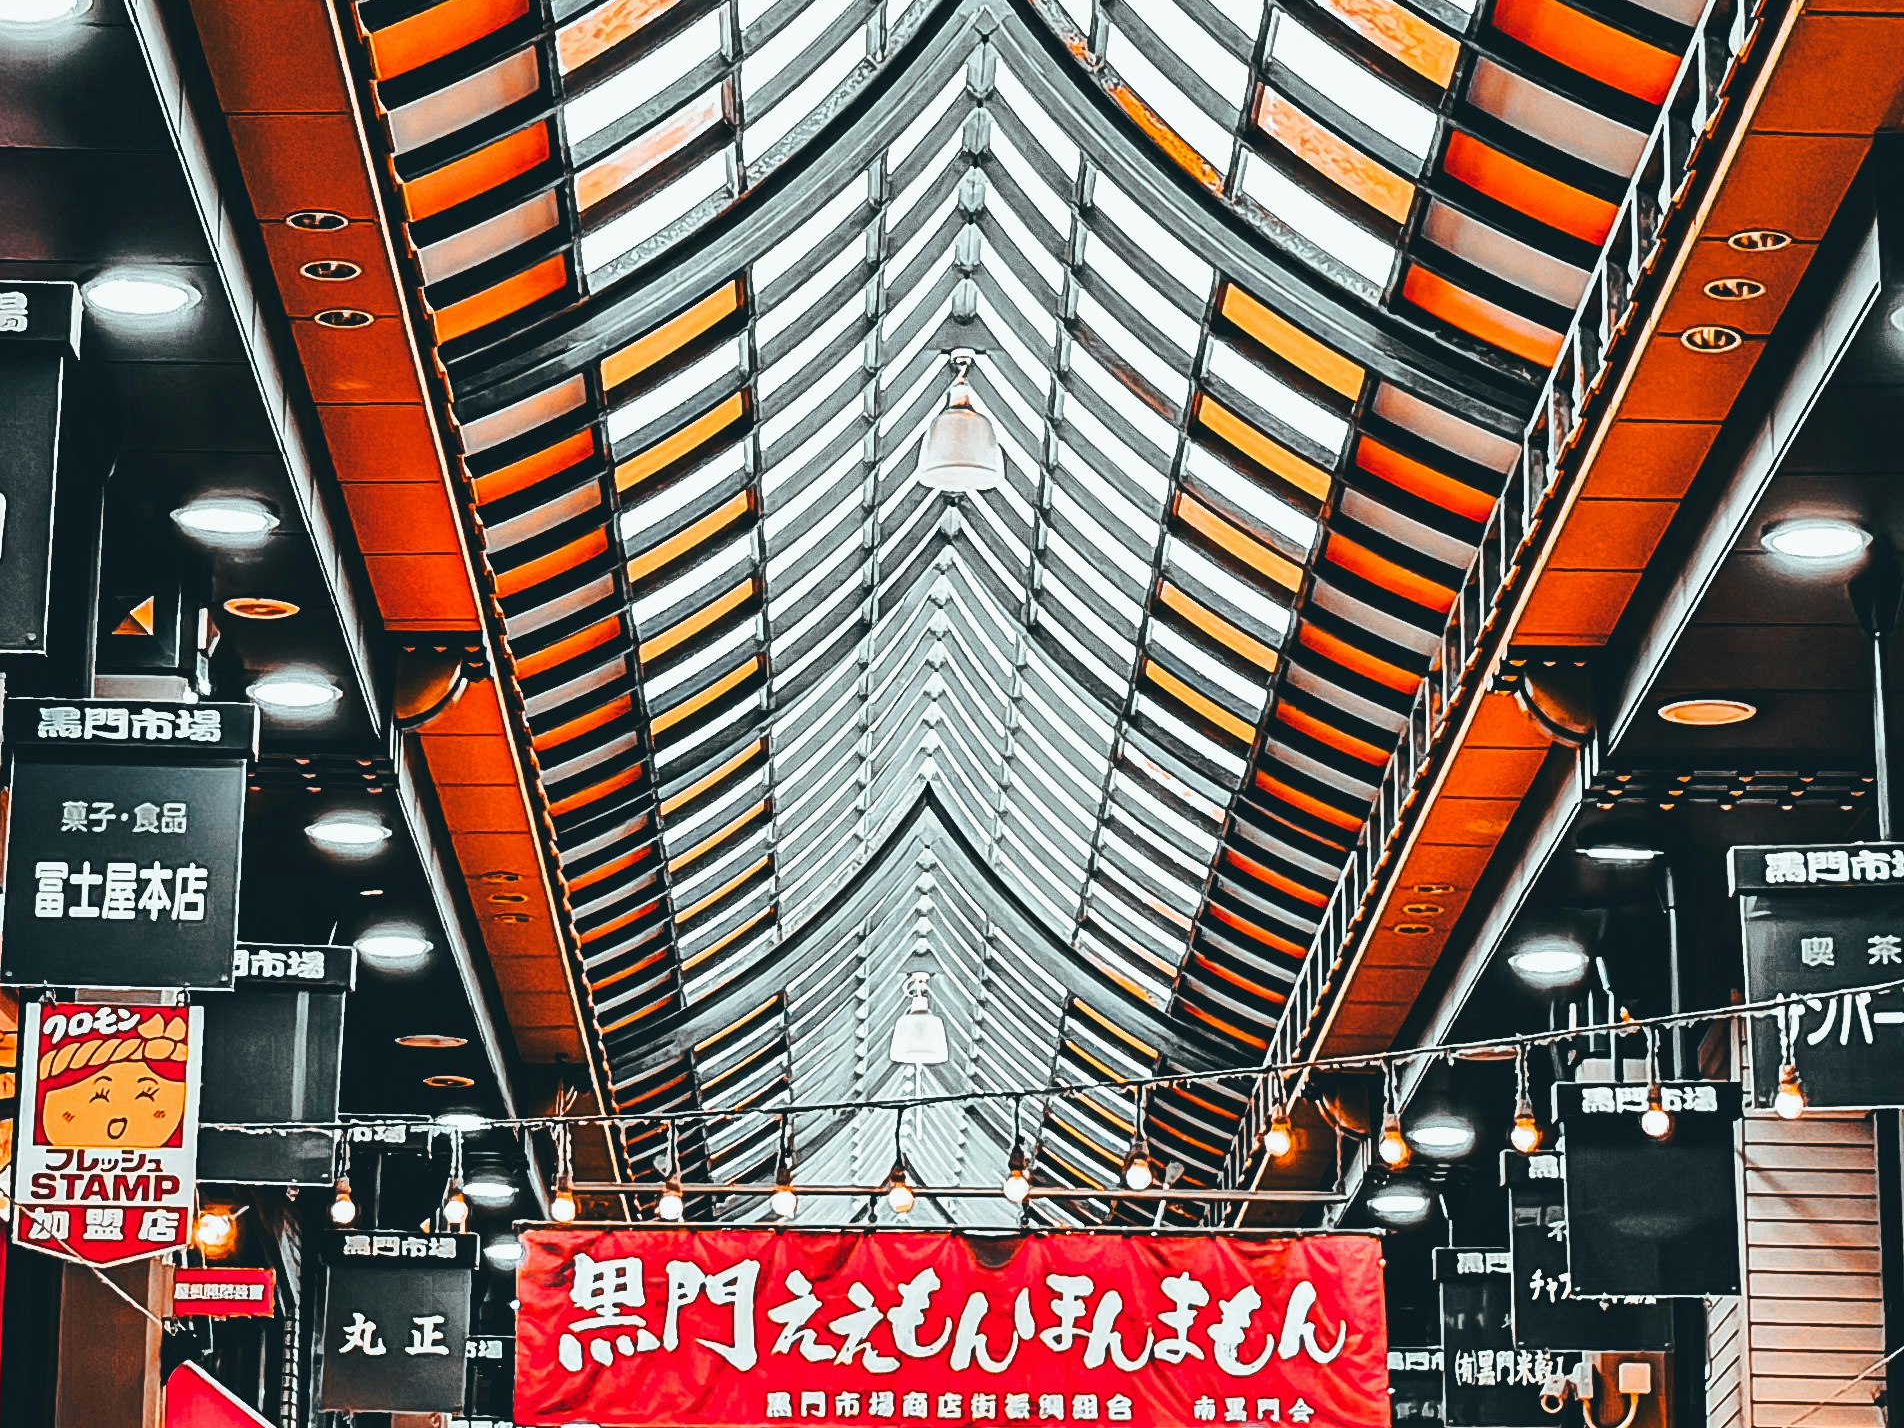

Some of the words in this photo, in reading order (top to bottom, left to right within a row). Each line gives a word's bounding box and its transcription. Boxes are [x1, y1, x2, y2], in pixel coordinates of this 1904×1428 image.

[37, 706, 222, 744] 黒門市場
[43, 1011, 141, 1040] クロモン
[45, 1149, 163, 1172] フレッシュ
[30, 1174, 181, 1202] STAMP
[29, 1208, 181, 1241] 加盟店
[342, 1234, 458, 1261] 黒門市場
[558, 1252, 1347, 1376] 黒門ええもんほんまもん
[339, 1311, 451, 1357] 丸正
